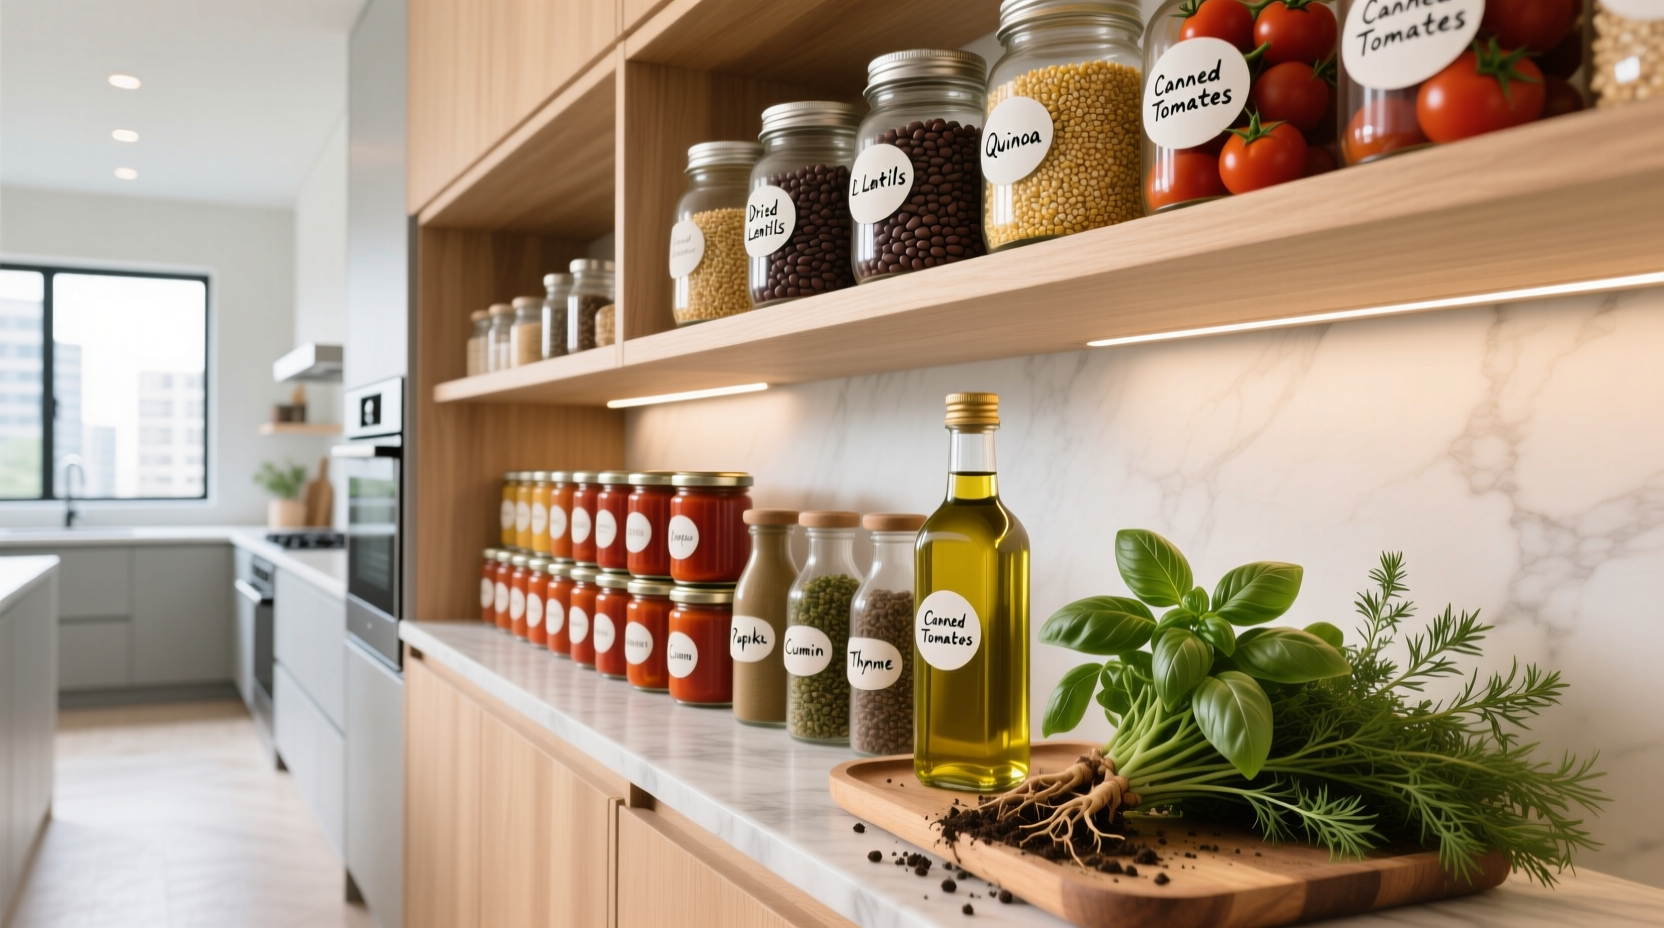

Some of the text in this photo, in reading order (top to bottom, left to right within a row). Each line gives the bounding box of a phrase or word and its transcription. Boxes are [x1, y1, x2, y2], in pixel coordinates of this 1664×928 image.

[1362, 0, 1452, 24] Cann
[1356, 9, 1467, 56] Tomates
[1154, 58, 1222, 97] Canned
[1151, 88, 1233, 122] Tomates
[985, 130, 1042, 159] Quinoa
[749, 198, 779, 223] Dried
[923, 609, 967, 629] Canned
[785, 637, 824, 657] Cumin
